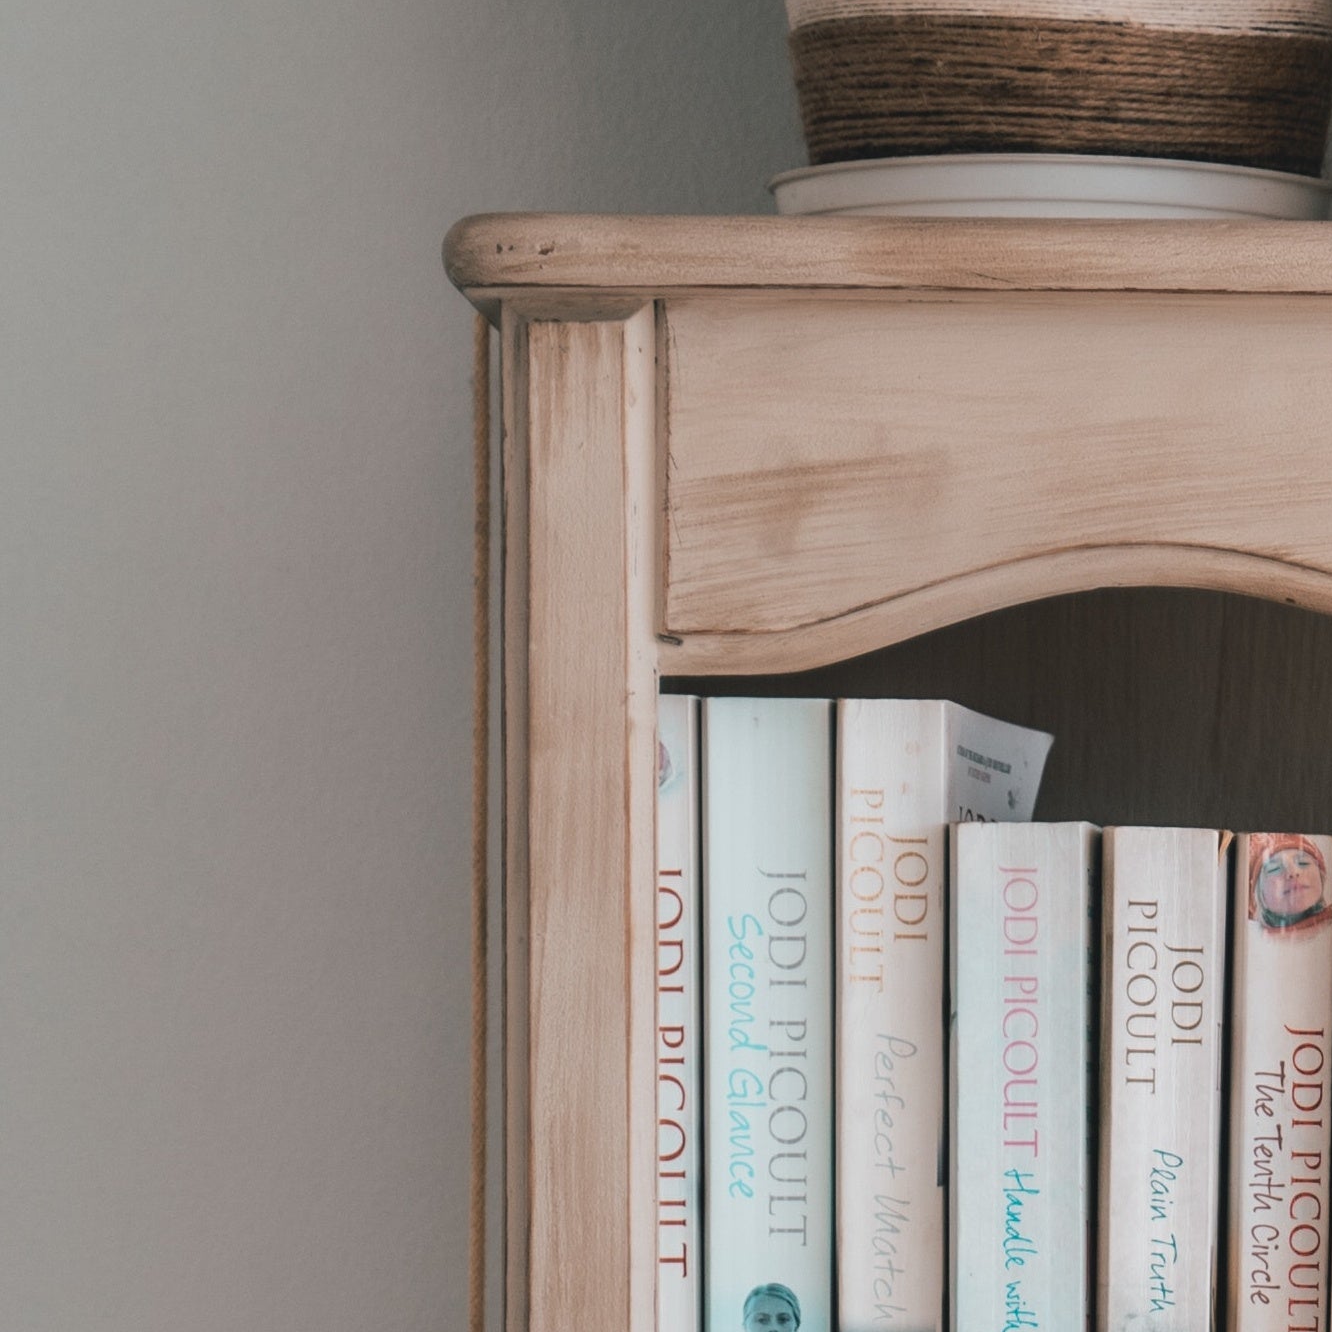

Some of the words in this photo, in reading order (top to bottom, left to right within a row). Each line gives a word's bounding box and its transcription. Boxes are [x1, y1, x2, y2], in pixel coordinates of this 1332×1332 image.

[757, 867, 808, 989] JODI
[1001, 866, 1037, 956] JODI
[726, 914, 763, 1051] Second
[1124, 899, 1158, 1094] PICOULT
[1166, 944, 1203, 1047] JODI
[1002, 976, 1037, 1157] PICOULT
[728, 1069, 759, 1199] Glance
[768, 1019, 808, 1246] PICOULT
[1149, 1150, 1184, 1221] Plain
[1002, 1169, 1039, 1271] Handle
[1149, 1234, 1177, 1313] Truth
